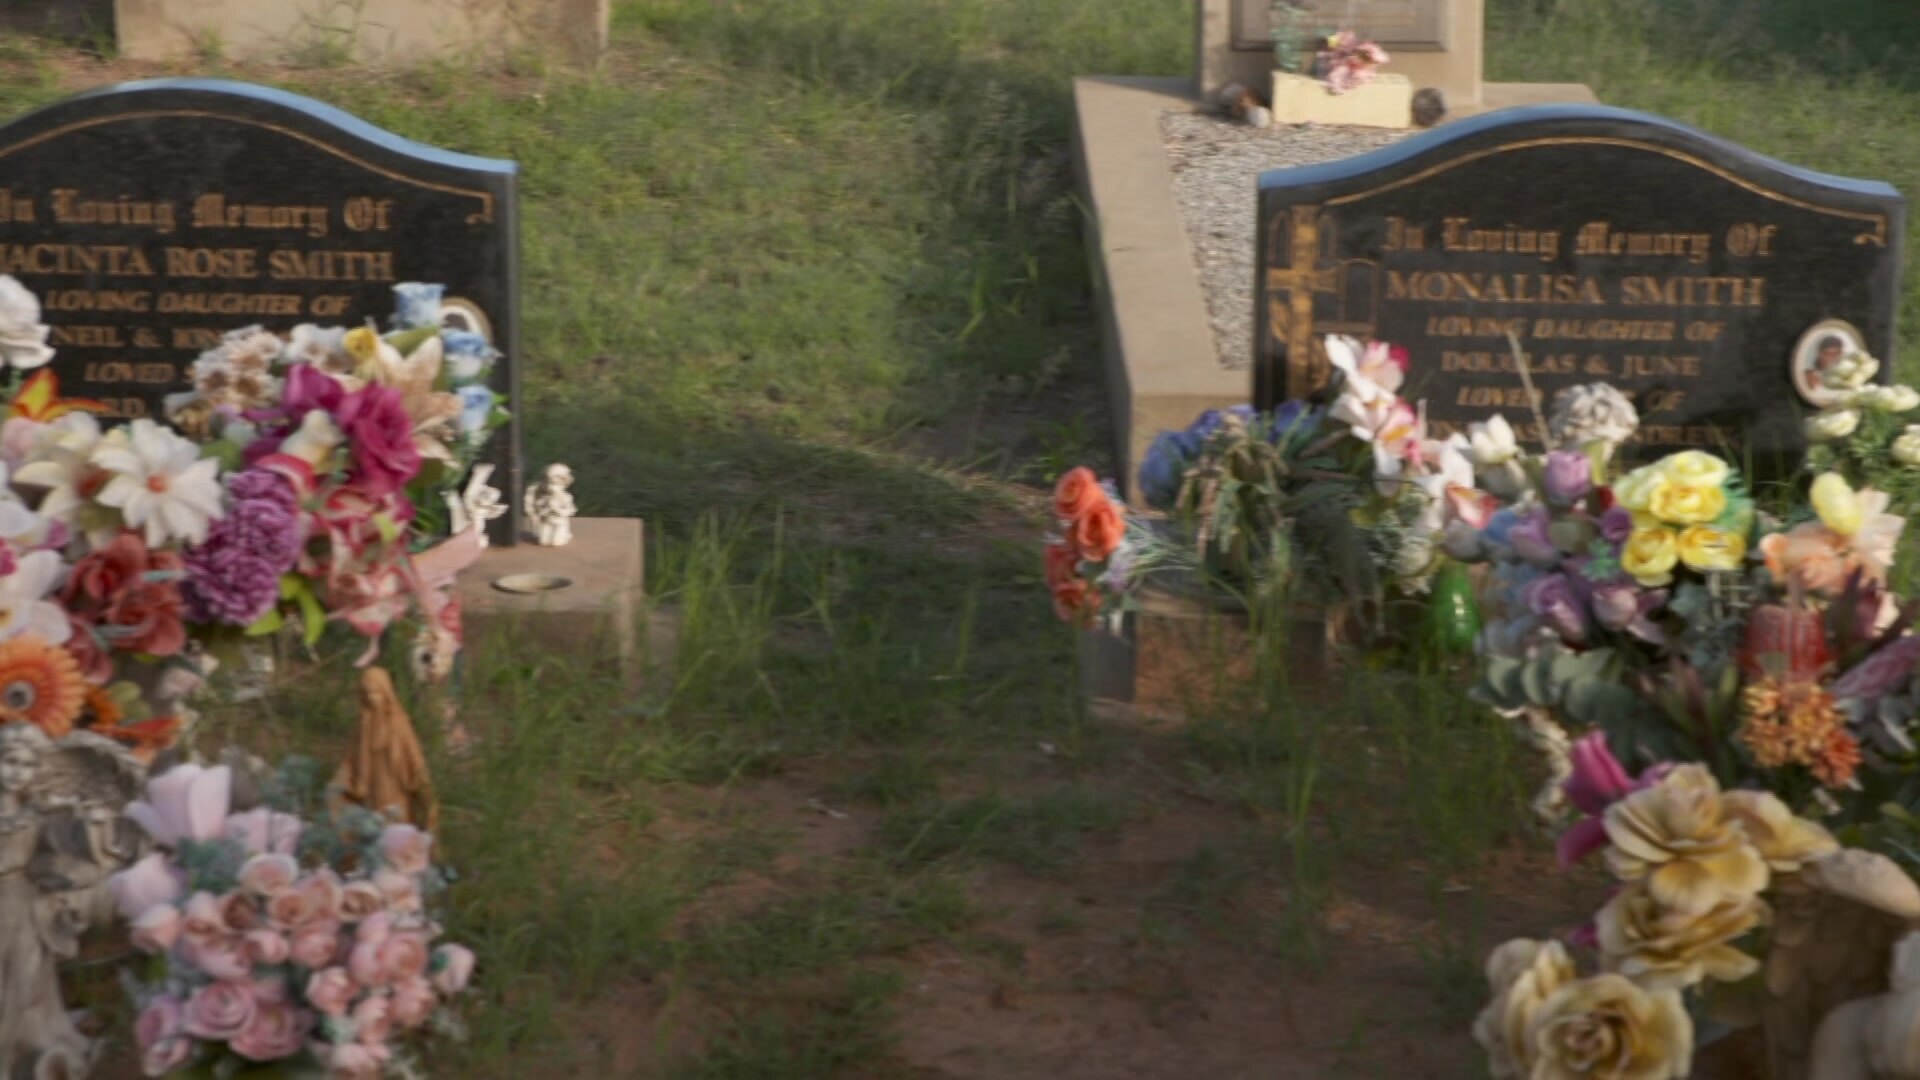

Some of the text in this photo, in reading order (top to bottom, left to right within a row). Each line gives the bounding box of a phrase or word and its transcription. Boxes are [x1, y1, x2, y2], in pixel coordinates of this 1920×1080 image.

[51, 187, 176, 234] Loving
[191, 193, 329, 239] Memory
[343, 196, 395, 232] Of
[1381, 215, 1778, 265] In Loving Memory Of
[165, 246, 258, 279] ROSE
[268, 249, 397, 281] SMITH
[46, 289, 352, 316] LOVING DAUGHTER OF
[1386, 270, 1768, 306] MONALISA SMITH
[1425, 316, 1727, 342] LOVING DAUGHTER OF
[84, 361, 177, 384] LOVED
[1618, 355, 1701, 380] JUNE
